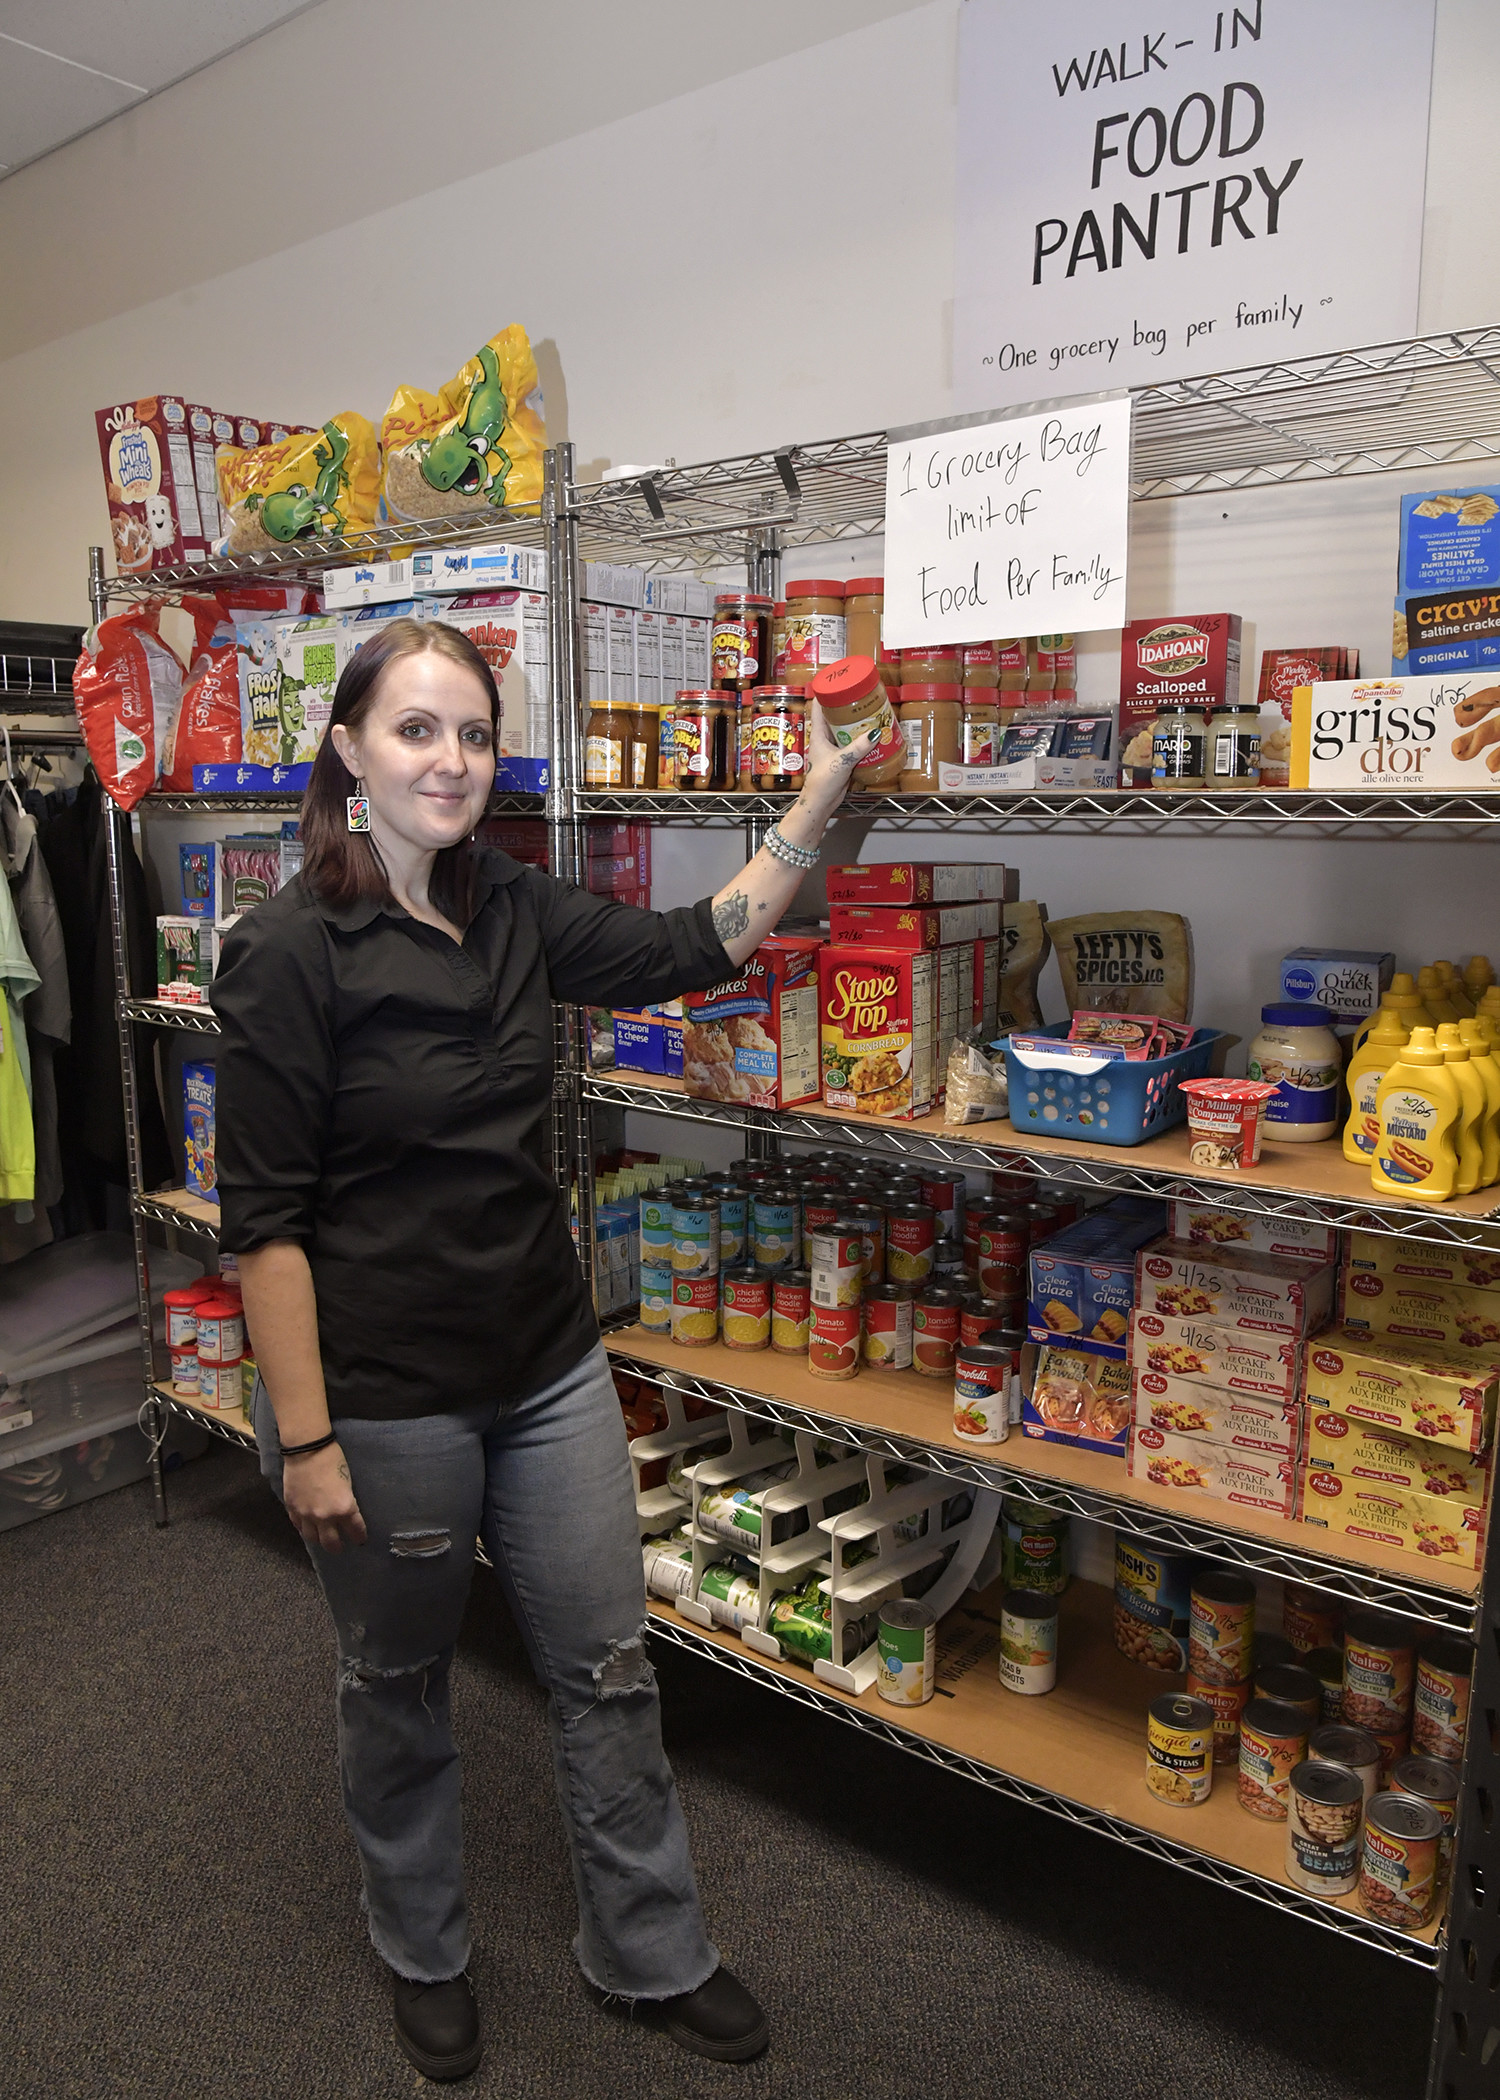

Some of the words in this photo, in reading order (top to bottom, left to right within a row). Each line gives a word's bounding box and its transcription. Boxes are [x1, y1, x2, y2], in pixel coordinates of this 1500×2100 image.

[1213, 0, 1263, 53] IN
[1090, 82, 1265, 189] FOOD
[1031, 158, 1304, 286] PANTRY
[1049, 333, 1119, 370] grocery
[1133, 321, 1167, 355] bag
[1187, 316, 1218, 349] per
[1235, 293, 1303, 329] family
[121, 433, 143, 448] Frosted
[119, 442, 147, 466] Mini
[900, 451, 917, 496] 1
[927, 442, 1030, 489] Grocery
[1040, 419, 1107, 477] Bag
[119, 460, 152, 487] Wheats
[948, 496, 1001, 540] limit
[1431, 549, 1475, 561] SALTINES
[1419, 568, 1454, 577] FLAVOR!
[1457, 565, 1489, 575] CRAV'N
[918, 561, 988, 619] Food
[1008, 557, 1040, 600] Per
[1053, 554, 1123, 601] Family
[793, 620, 823, 637] 7/25
[1421, 624, 1460, 639] saltine
[1141, 638, 1204, 663] IDAHOAN
[1419, 650, 1469, 664] ORIGINAL
[1282, 666, 1311, 676] Maddy's
[247, 670, 282, 697] FROS
[1136, 678, 1206, 695] Scalloped
[1275, 675, 1297, 688] Sweet
[1363, 687, 1402, 698] panealba
[121, 686, 134, 718] corn
[1126, 699, 1153, 707] SLICED
[1312, 698, 1436, 761] griss
[1154, 739, 1191, 751] MARIO
[1360, 736, 1432, 774] d'or
[1362, 774, 1378, 783] alle
[1379, 774, 1402, 783] olive
[1403, 773, 1423, 783] nere
[1073, 933, 1164, 960] LEFTY'S
[1285, 978, 1316, 990] Pillsbury
[1323, 972, 1373, 992] Quick
[827, 970, 898, 1020] Stove
[1316, 987, 1373, 1009] Bread
[850, 999, 888, 1034] Top
[886, 1017, 909, 1028] Stuffing
[617, 1021, 649, 1034] macaroni
[888, 1026, 899, 1034] Mix
[624, 1033, 649, 1044] cheese
[847, 1036, 905, 1052] CORNBREAD
[737, 1058, 759, 1069] MEAL
[761, 1061, 776, 1070] KIT
[739, 1051, 773, 1062] COMPLETE
[187, 1087, 212, 1106] TREATS
[1205, 1100, 1242, 1113] Milling
[1192, 1107, 1235, 1122] Company
[1392, 1115, 1419, 1128] Yellow
[1387, 1123, 1426, 1141] MUSTARD
[892, 1224, 920, 1233] chicken
[893, 1231, 918, 1240] noodle
[993, 1241, 1021, 1250] tomato
[1044, 1275, 1070, 1287] Clear
[1177, 1265, 1222, 1293] 4/25
[737, 1288, 764, 1296] chicken
[777, 1291, 803, 1301] chicken
[1037, 1282, 1073, 1298] Glaze
[1101, 1284, 1128, 1295] Clear
[737, 1295, 762, 1304] noodle
[777, 1299, 801, 1307] noodle
[1093, 1291, 1131, 1308] Glaze
[818, 1317, 845, 1327] tomato
[928, 1316, 955, 1325] tomato
[1180, 1326, 1216, 1351] 4/25
[1046, 1354, 1089, 1373] Baking
[1315, 1355, 1341, 1370] Forchy
[1042, 1365, 1088, 1382] Powder
[958, 1387, 979, 1396] GRAVY
[960, 1382, 976, 1390] BEEF
[1368, 1380, 1398, 1396] CAKE
[1348, 1386, 1369, 1399] AUX
[1370, 1392, 1407, 1409] FRUITS
[1244, 1425, 1279, 1440] FRUITS
[1317, 1419, 1346, 1434] Forchy
[1363, 1442, 1373, 1450] LE
[1374, 1442, 1406, 1457] CAKE
[1353, 1448, 1376, 1461] AUX
[1378, 1455, 1416, 1469] FRUITS
[1377, 1463, 1402, 1473] BEURRE
[1237, 1472, 1266, 1486] CAKE
[1311, 1478, 1340, 1492] Forchy
[1218, 1477, 1238, 1488] AUX
[1240, 1482, 1274, 1497] FRUITS
[1356, 1502, 1366, 1510] LE
[1367, 1502, 1399, 1518] CAKE
[1346, 1507, 1369, 1520] AUX
[1370, 1514, 1408, 1530] FRUITS
[1128, 1592, 1161, 1616] Beans
[1001, 1658, 1015, 1674] PEAS
[1015, 1665, 1021, 1674] &
[1349, 1651, 1388, 1672] Nalley
[1199, 1693, 1235, 1708] Nalley
[1173, 1756, 1199, 1767] STEMS
[1295, 1843, 1328, 1857] NORTHERN
[1300, 1840, 1320, 1851] GREAT
[1366, 1830, 1401, 1860] Nalley
[1303, 1856, 1353, 1871] BEANS
